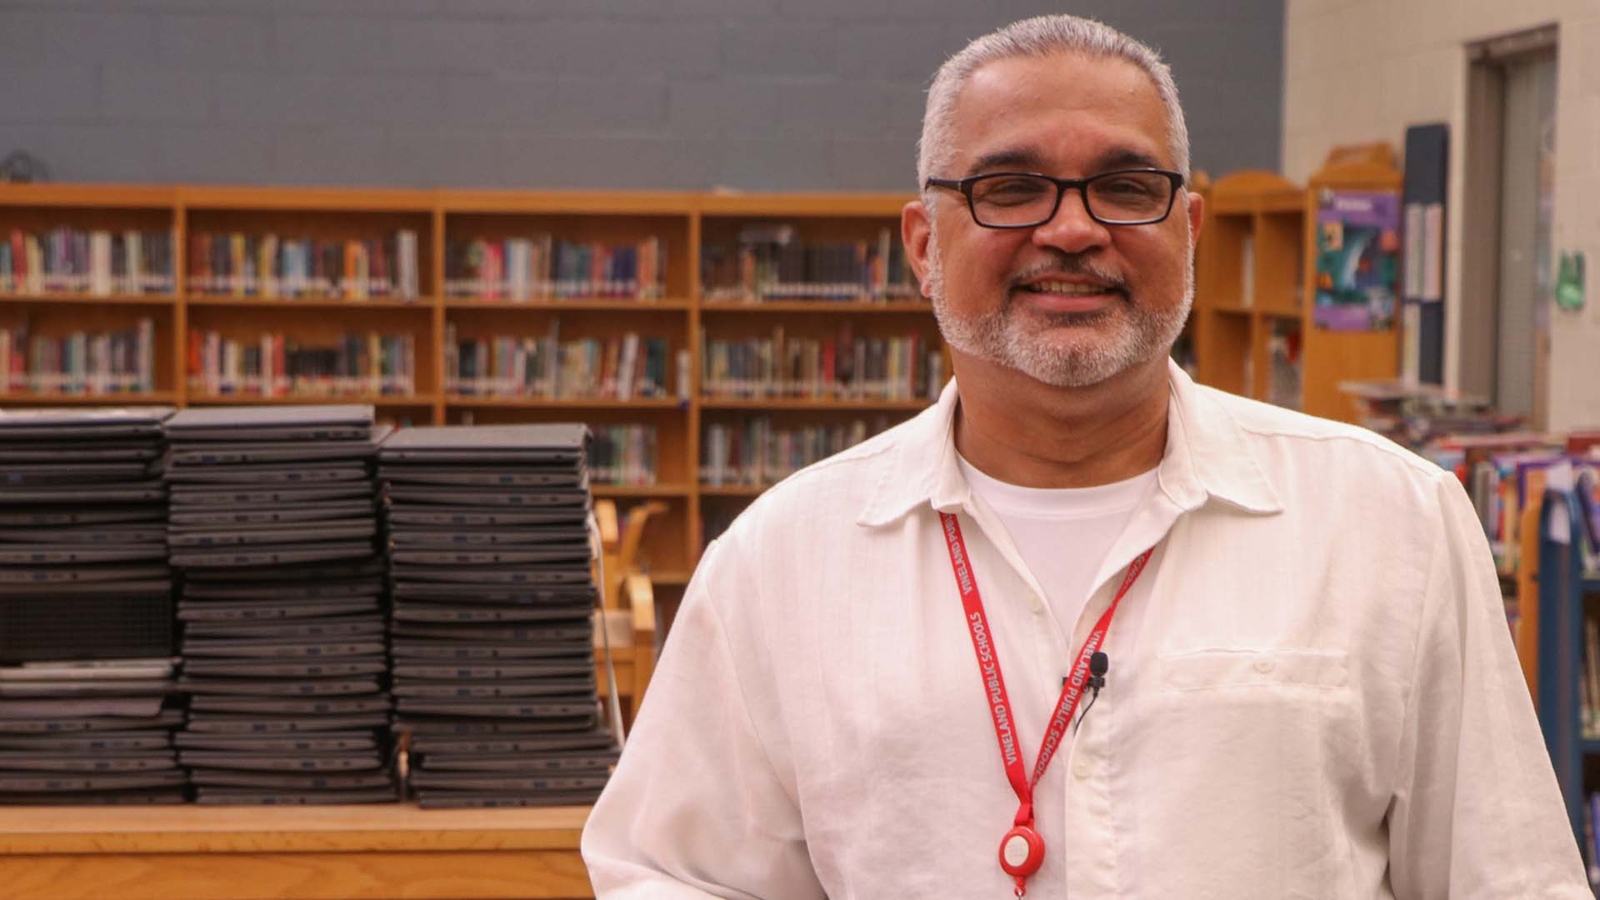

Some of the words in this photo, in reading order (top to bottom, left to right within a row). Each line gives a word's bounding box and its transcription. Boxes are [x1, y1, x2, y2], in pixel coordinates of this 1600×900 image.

[952, 542, 973, 596] VINELAND
[970, 611, 993, 662] SCHOOLS
[1072, 630, 1103, 687] VINELAND
[983, 662, 1003, 704] PUBLIC
[1054, 687, 1079, 730] PUBLIC
[995, 704, 1018, 766] VINELAND
